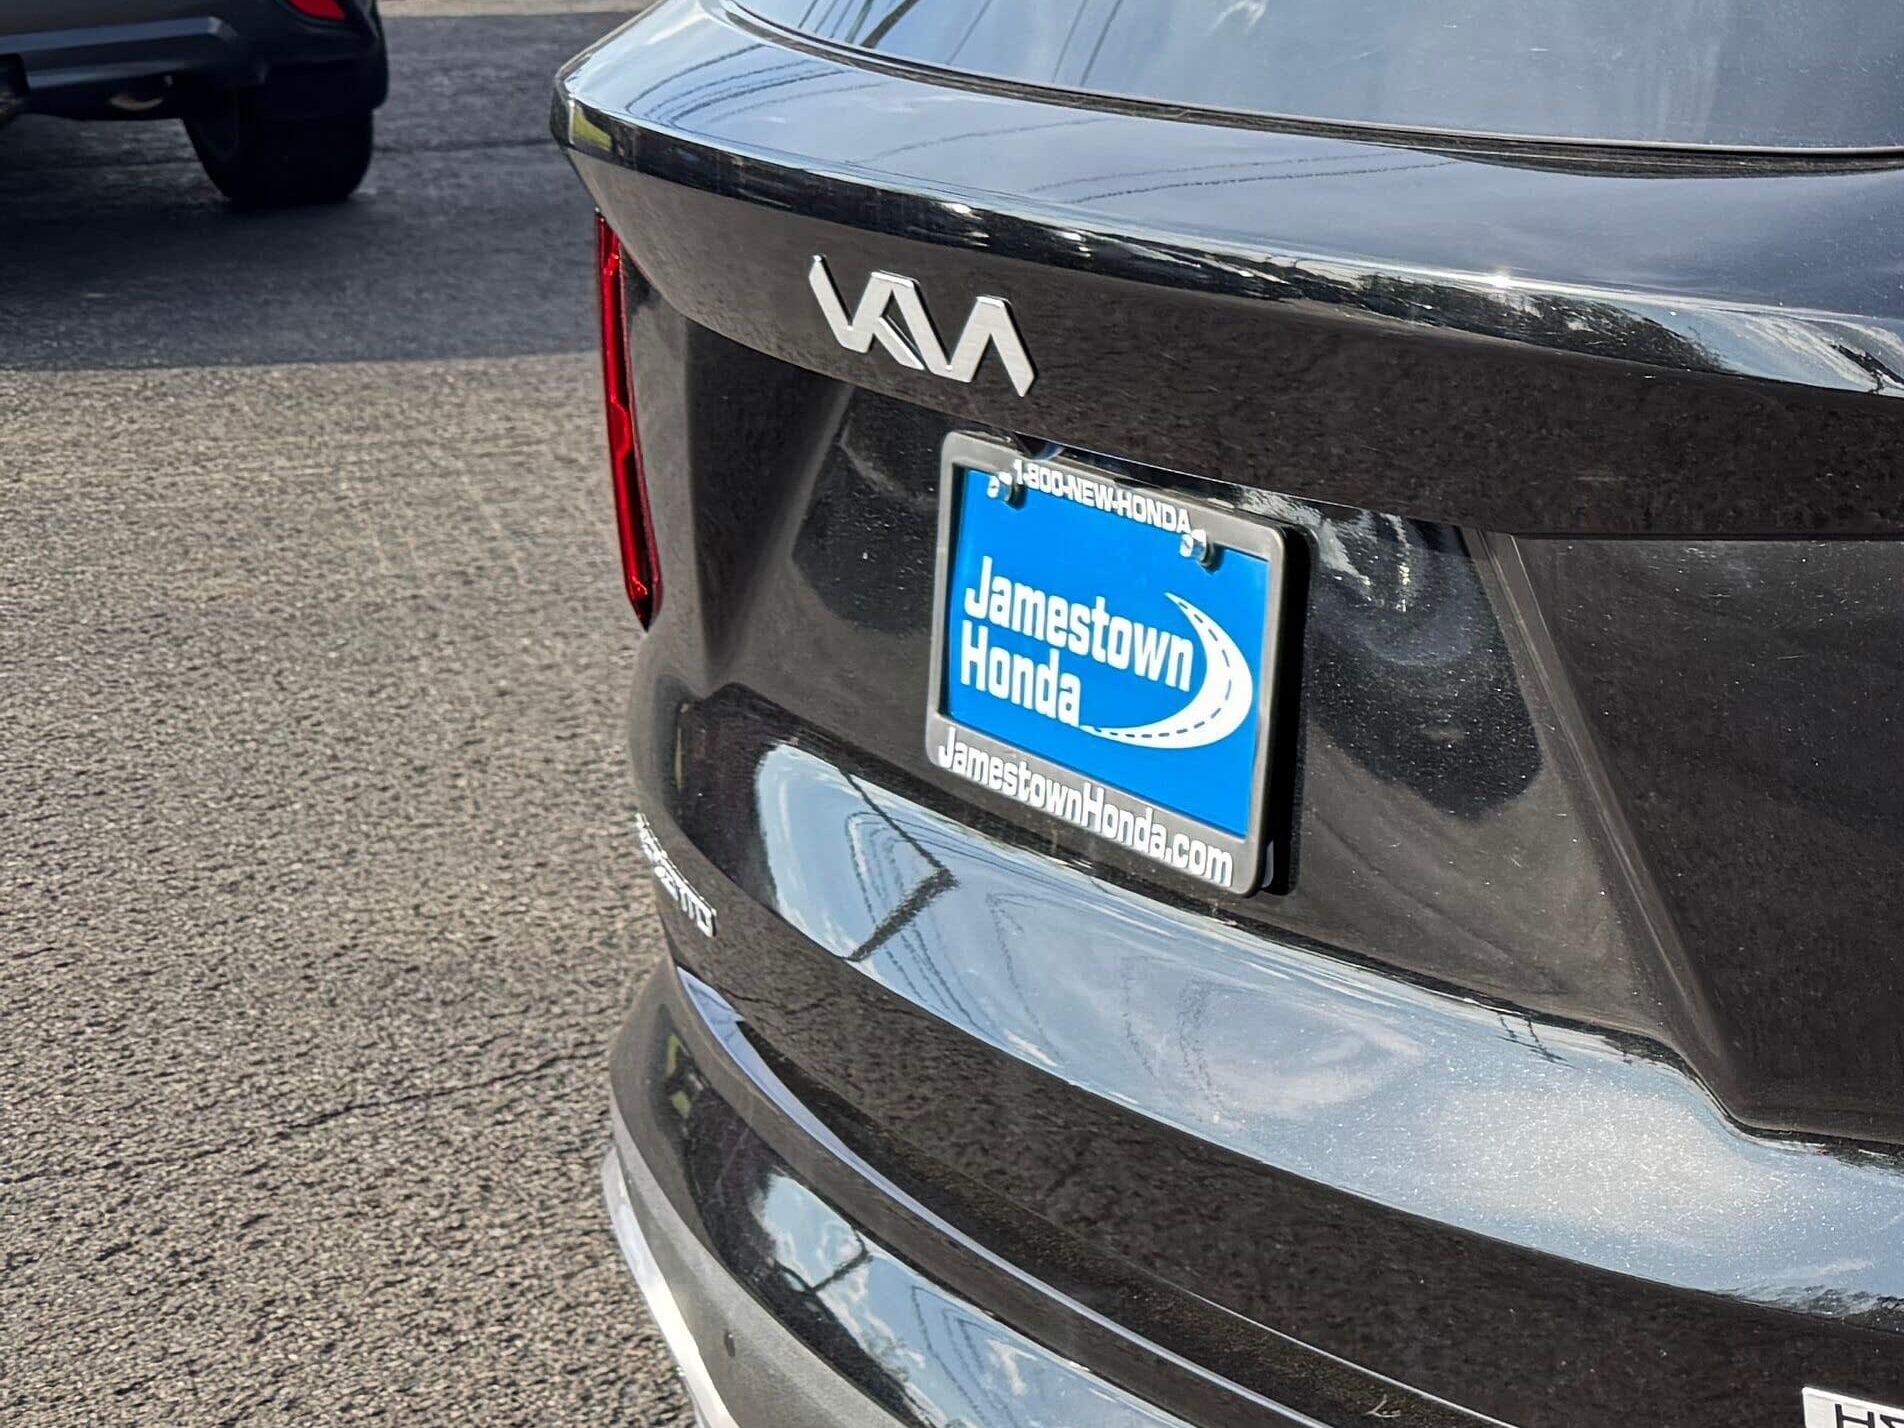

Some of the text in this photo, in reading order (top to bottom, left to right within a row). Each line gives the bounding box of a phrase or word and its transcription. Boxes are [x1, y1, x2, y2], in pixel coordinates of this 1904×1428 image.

[808, 254, 1036, 398] KIA
[1012, 459, 1192, 535] 1-800-NEW-HONDA
[960, 619, 1082, 728] Honda
[964, 555, 1194, 693] Jamestown
[938, 726, 1234, 888] JamestownHonda.com
